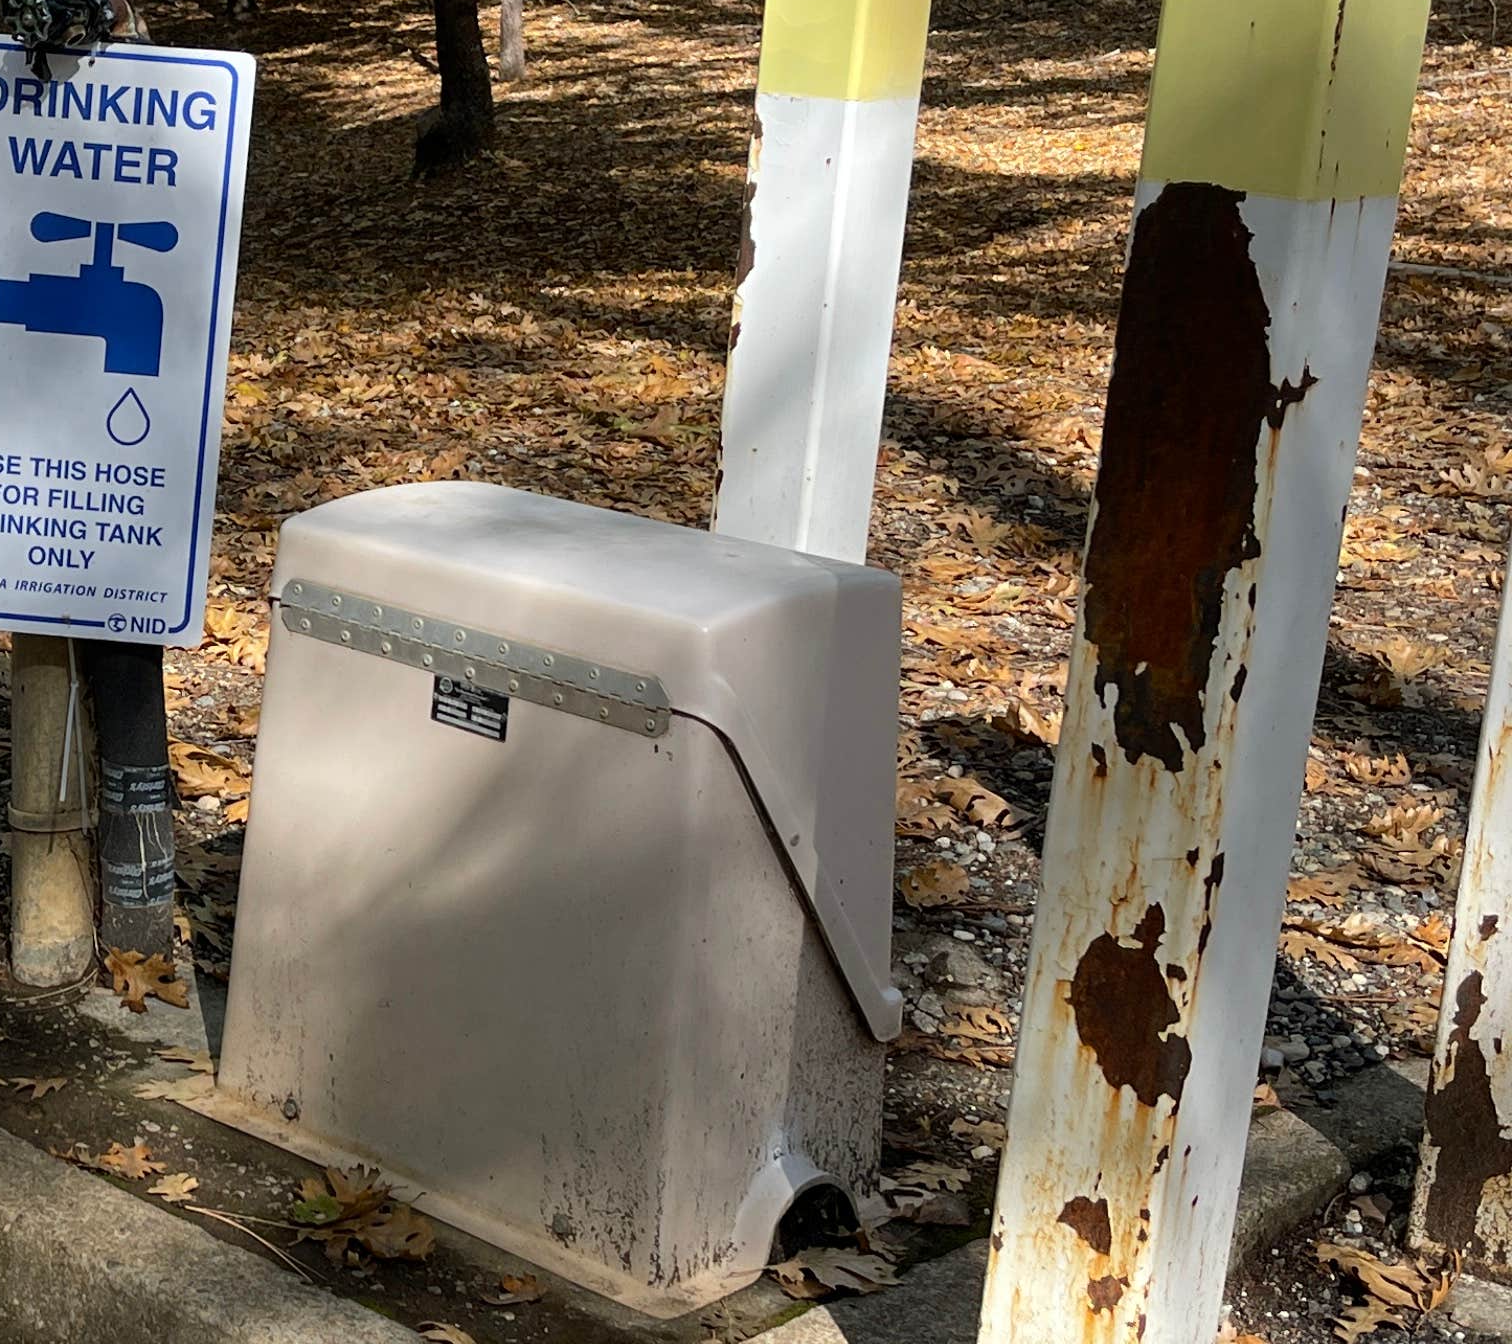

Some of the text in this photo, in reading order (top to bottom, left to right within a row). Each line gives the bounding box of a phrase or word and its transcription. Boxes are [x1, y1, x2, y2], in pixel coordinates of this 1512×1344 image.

[8, 136, 178, 187] WATER
[30, 456, 87, 481] THIS
[94, 463, 166, 488] HOSE
[48, 488, 145, 515] FILLING
[95, 522, 163, 546] TANK
[28, 545, 95, 570] ONLY
[14, 580, 96, 597] IRRIGATION
[103, 588, 168, 604] DISTRICT
[130, 617, 166, 634] NID
